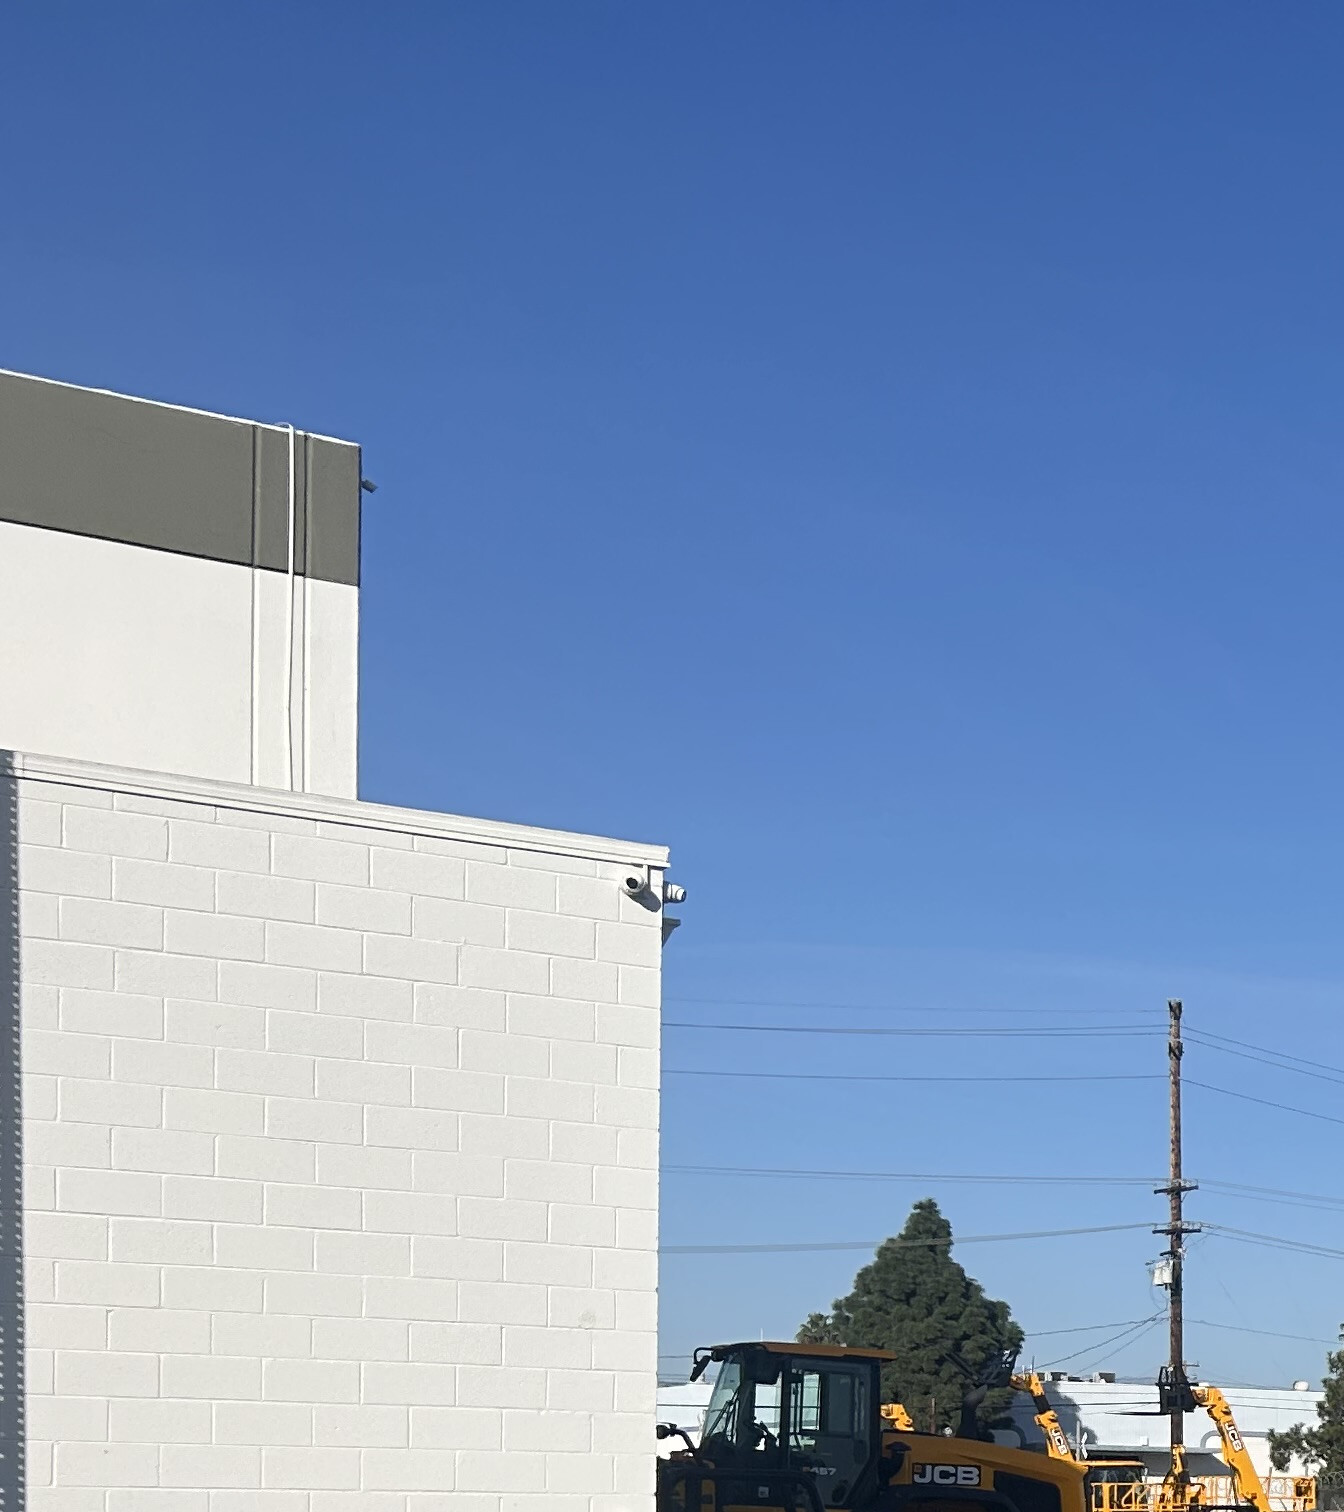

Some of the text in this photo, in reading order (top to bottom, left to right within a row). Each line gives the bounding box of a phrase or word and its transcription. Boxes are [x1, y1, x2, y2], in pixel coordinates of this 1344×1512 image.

[1049, 1428, 1068, 1456] JCB
[1225, 1422, 1243, 1451] JCB
[913, 1464, 979, 1485] JCB
